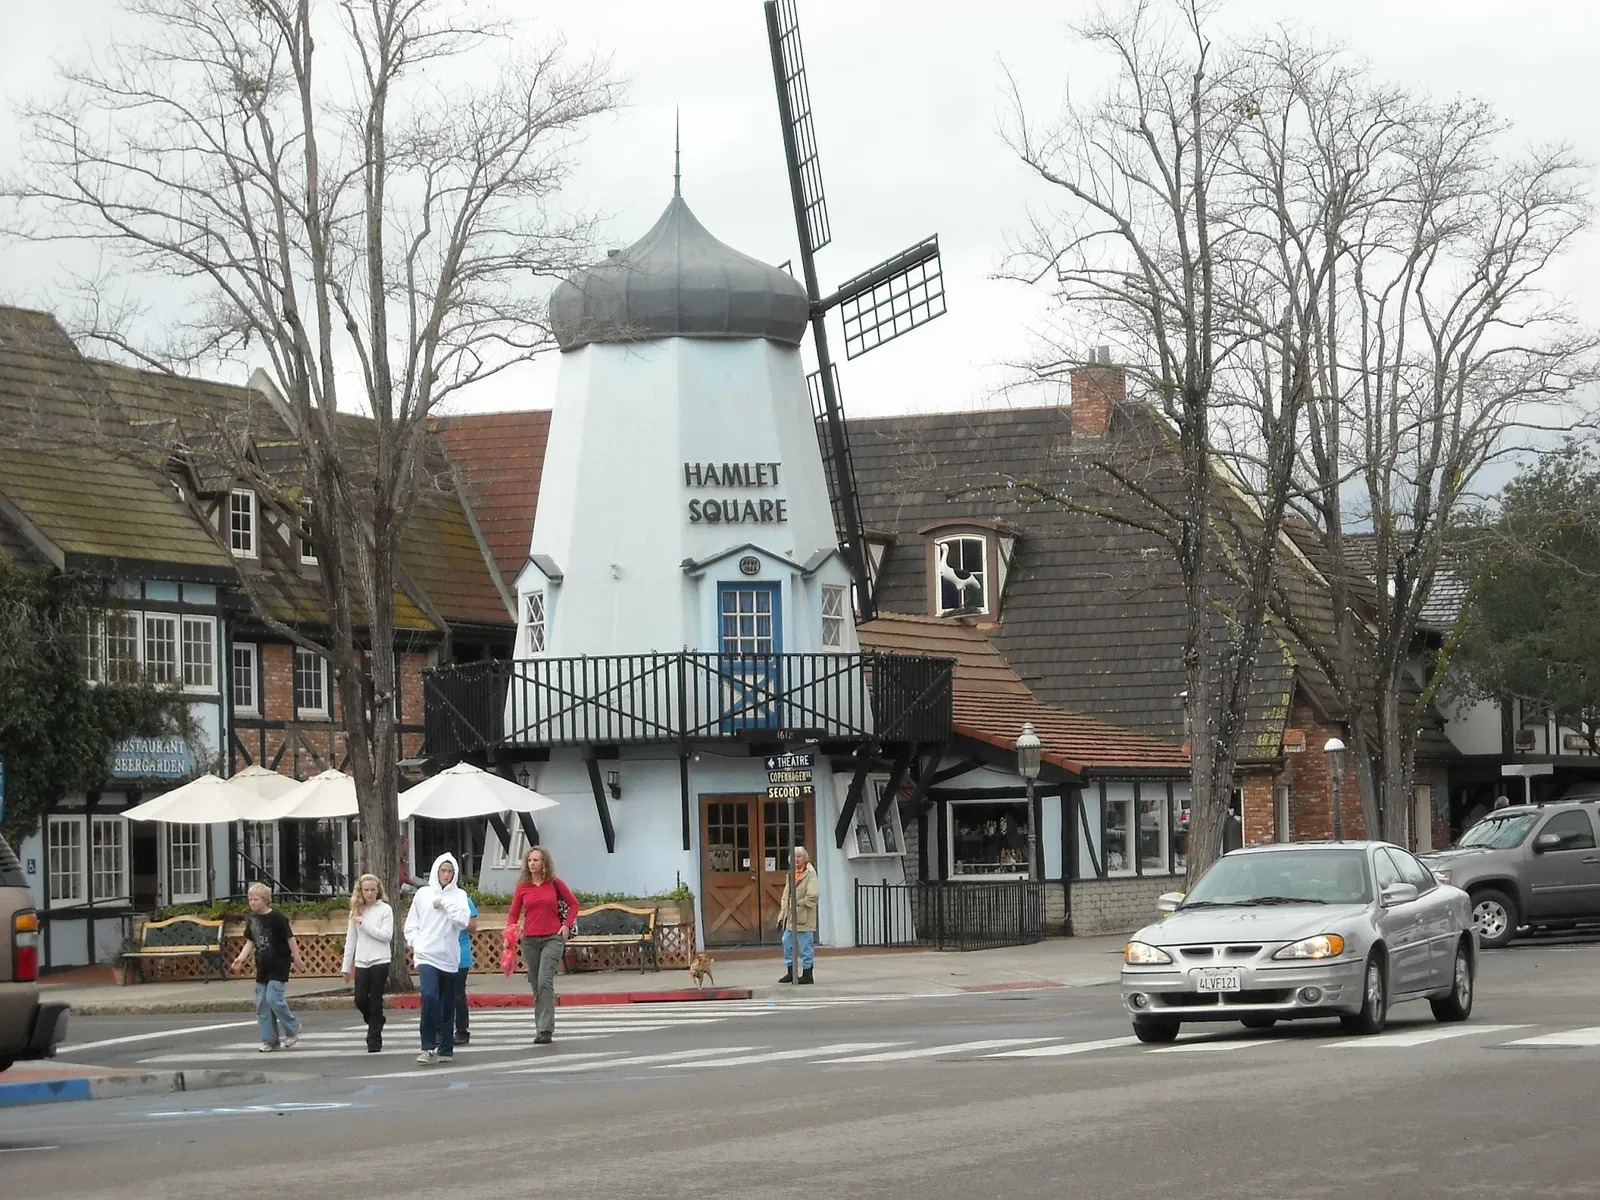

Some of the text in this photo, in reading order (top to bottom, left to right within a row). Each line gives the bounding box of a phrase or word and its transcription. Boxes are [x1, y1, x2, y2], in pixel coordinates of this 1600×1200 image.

[684, 462, 781, 486] HAMLET
[688, 498, 788, 523] SQUARE
[114, 758, 185, 773] BEERGARDEN
[776, 755, 810, 768] THEATRE
[769, 771, 806, 783] COPENHAGEN
[768, 786, 800, 798] SECOND
[1200, 977, 1237, 989] 4LVF121
